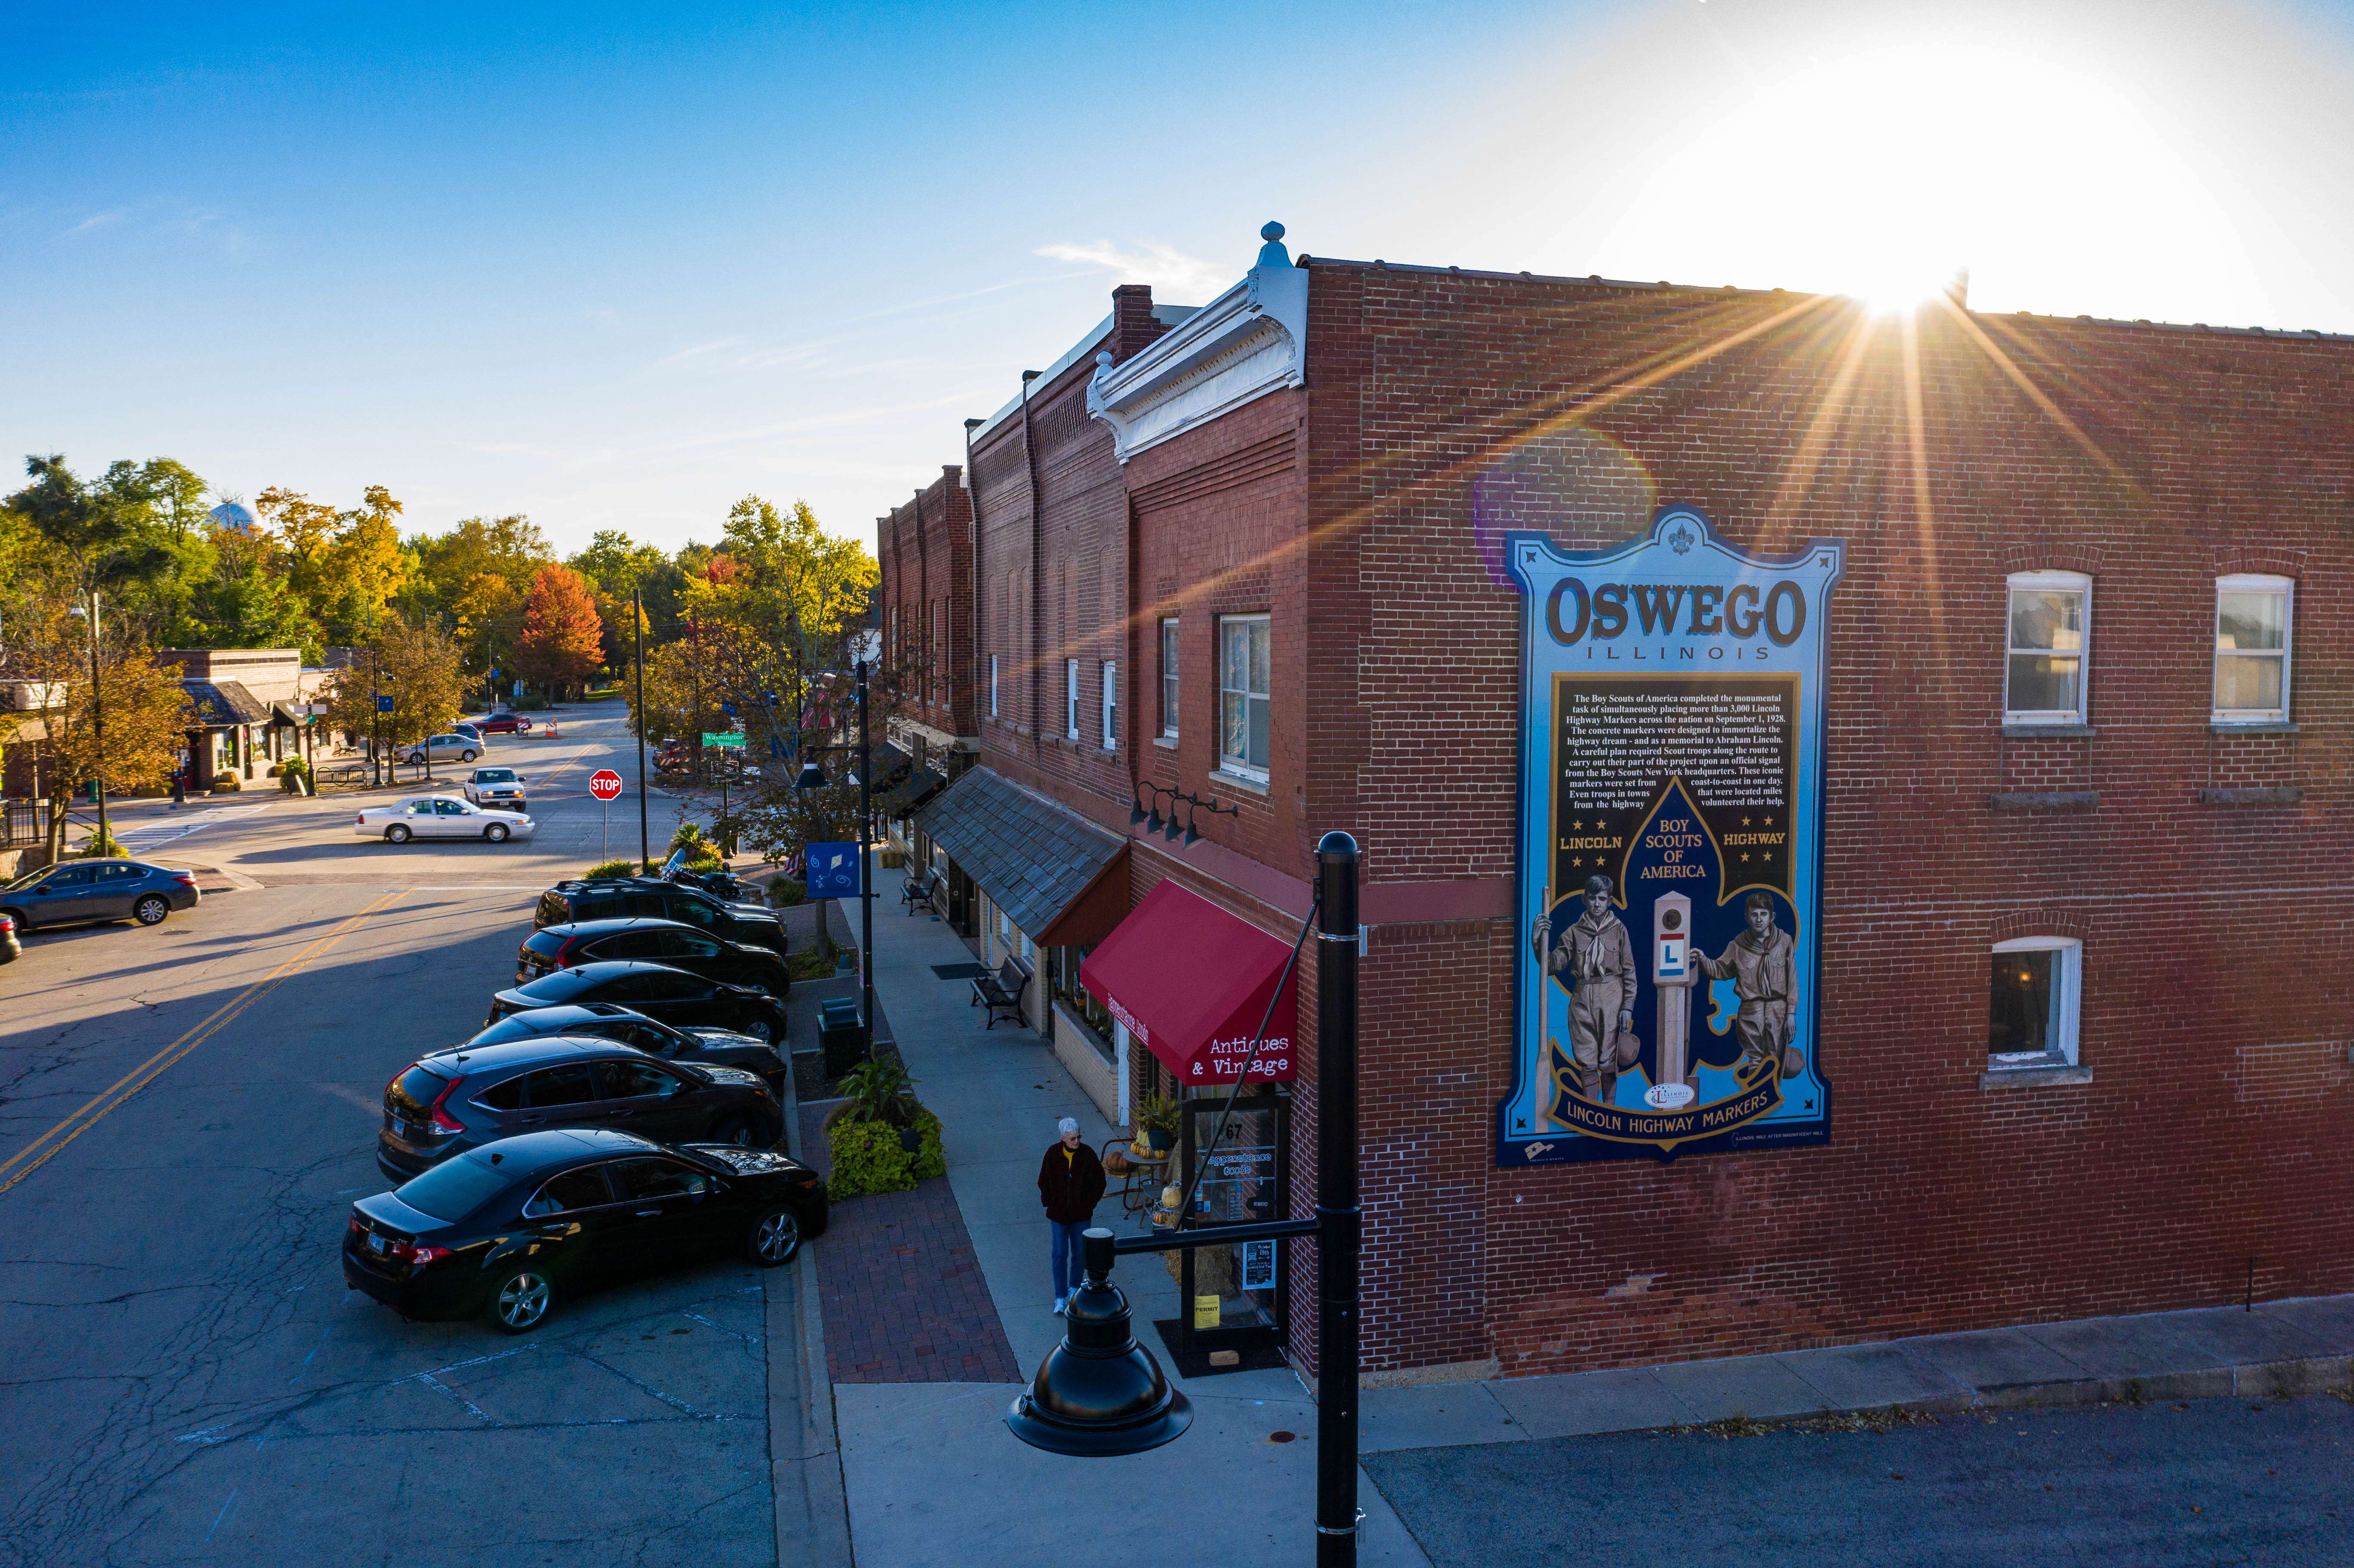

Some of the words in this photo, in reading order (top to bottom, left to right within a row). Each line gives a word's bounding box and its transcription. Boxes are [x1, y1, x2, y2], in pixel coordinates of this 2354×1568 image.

[1545, 577, 1806, 646] OSWEGO
[1588, 647, 1769, 660] ILLINOIS
[1574, 694, 1589, 703] The
[1592, 694, 1607, 705] Boy
[1680, 694, 1718, 704] completed
[1721, 694, 1732, 702] the
[1734, 694, 1781, 702] monumental
[1572, 705, 1588, 713] task
[1591, 705, 1599, 713] of
[1600, 705, 1658, 715] simultaneously
[1660, 705, 1688, 715] placing
[1711, 704, 1728, 712] than
[1730, 704, 1750, 714] 3,000
[1752, 704, 1780, 712] Lincoln
[1566, 716, 1600, 726] Highway
[1603, 716, 1636, 724] Markers
[1664, 715, 1676, 723] the
[1678, 715, 1702, 723] nation
[1716, 715, 1756, 725] September
[1759, 715, 1764, 724] 1,
[1767, 714, 1785, 722] 1928.
[1571, 726, 1586, 734] The
[1623, 726, 1655, 734] markers
[1677, 725, 1710, 736] designed
[1722, 725, 1766, 733] immortalize
[1567, 737, 1600, 747] highway
[1634, 736, 1648, 744] and
[1668, 736, 1704, 744] memorial
[1753, 735, 1783, 744] Lincoln.
[1581, 747, 1607, 756] careful
[1610, 747, 1626, 757] plan
[1629, 747, 1661, 757] required
[1664, 747, 1685, 755] Scout
[1687, 747, 1711, 756] troops
[1713, 746, 1733, 756] along
[1735, 746, 1747, 754] the
[1607, 758, 1626, 766] their
[1628, 758, 1644, 768] part
[1646, 757, 1655, 765] of
[1656, 757, 1668, 765] the
[1670, 757, 1697, 767] project
[1699, 759, 1717, 767] upon
[1731, 756, 1756, 764] official
[1759, 756, 1780, 766] signal
[1565, 769, 1584, 777] from
[1586, 768, 1598, 777] the
[1600, 768, 1616, 778] Boy
[1618, 768, 1643, 776] Scouts
[1645, 768, 1662, 776] New
[1685, 767, 1736, 777] headquarters.
[1738, 766, 1760, 775] These
[1762, 766, 1783, 774] iconic
[592, 778, 620, 791] STOP
[1570, 779, 1602, 787] markers
[1768, 777, 1782, 786] day.
[1569, 790, 1588, 798] Even
[1591, 790, 1615, 800] troops
[1618, 789, 1625, 797] in
[1734, 787, 1761, 795] located
[1763, 787, 1782, 795] miles
[1574, 800, 1592, 809] from
[1613, 800, 1644, 810] highway
[1701, 797, 1744, 806] volunteered
[1766, 797, 1784, 807] help.
[1660, 819, 1689, 832] BOY
[1560, 836, 1622, 849] LINCOLN
[1645, 834, 1702, 848] SCOUTS
[1724, 833, 1785, 846] HIGHWAY
[1663, 850, 1684, 863] OF
[1640, 865, 1706, 879] AMERICA
[1665, 945, 1678, 963] L
[1108, 992, 1135, 1030] Happenstance
[1137, 1019, 1149, 1042] Goods
[1193, 1062, 1203, 1075] &
[1568, 1101, 1621, 1131] LINCOLN
[1629, 1116, 1694, 1133] HIGHWAY
[1703, 1091, 1768, 1127] MARKERS
[1226, 1123, 1242, 1140] 67
[1224, 1164, 1252, 1176] Goods
